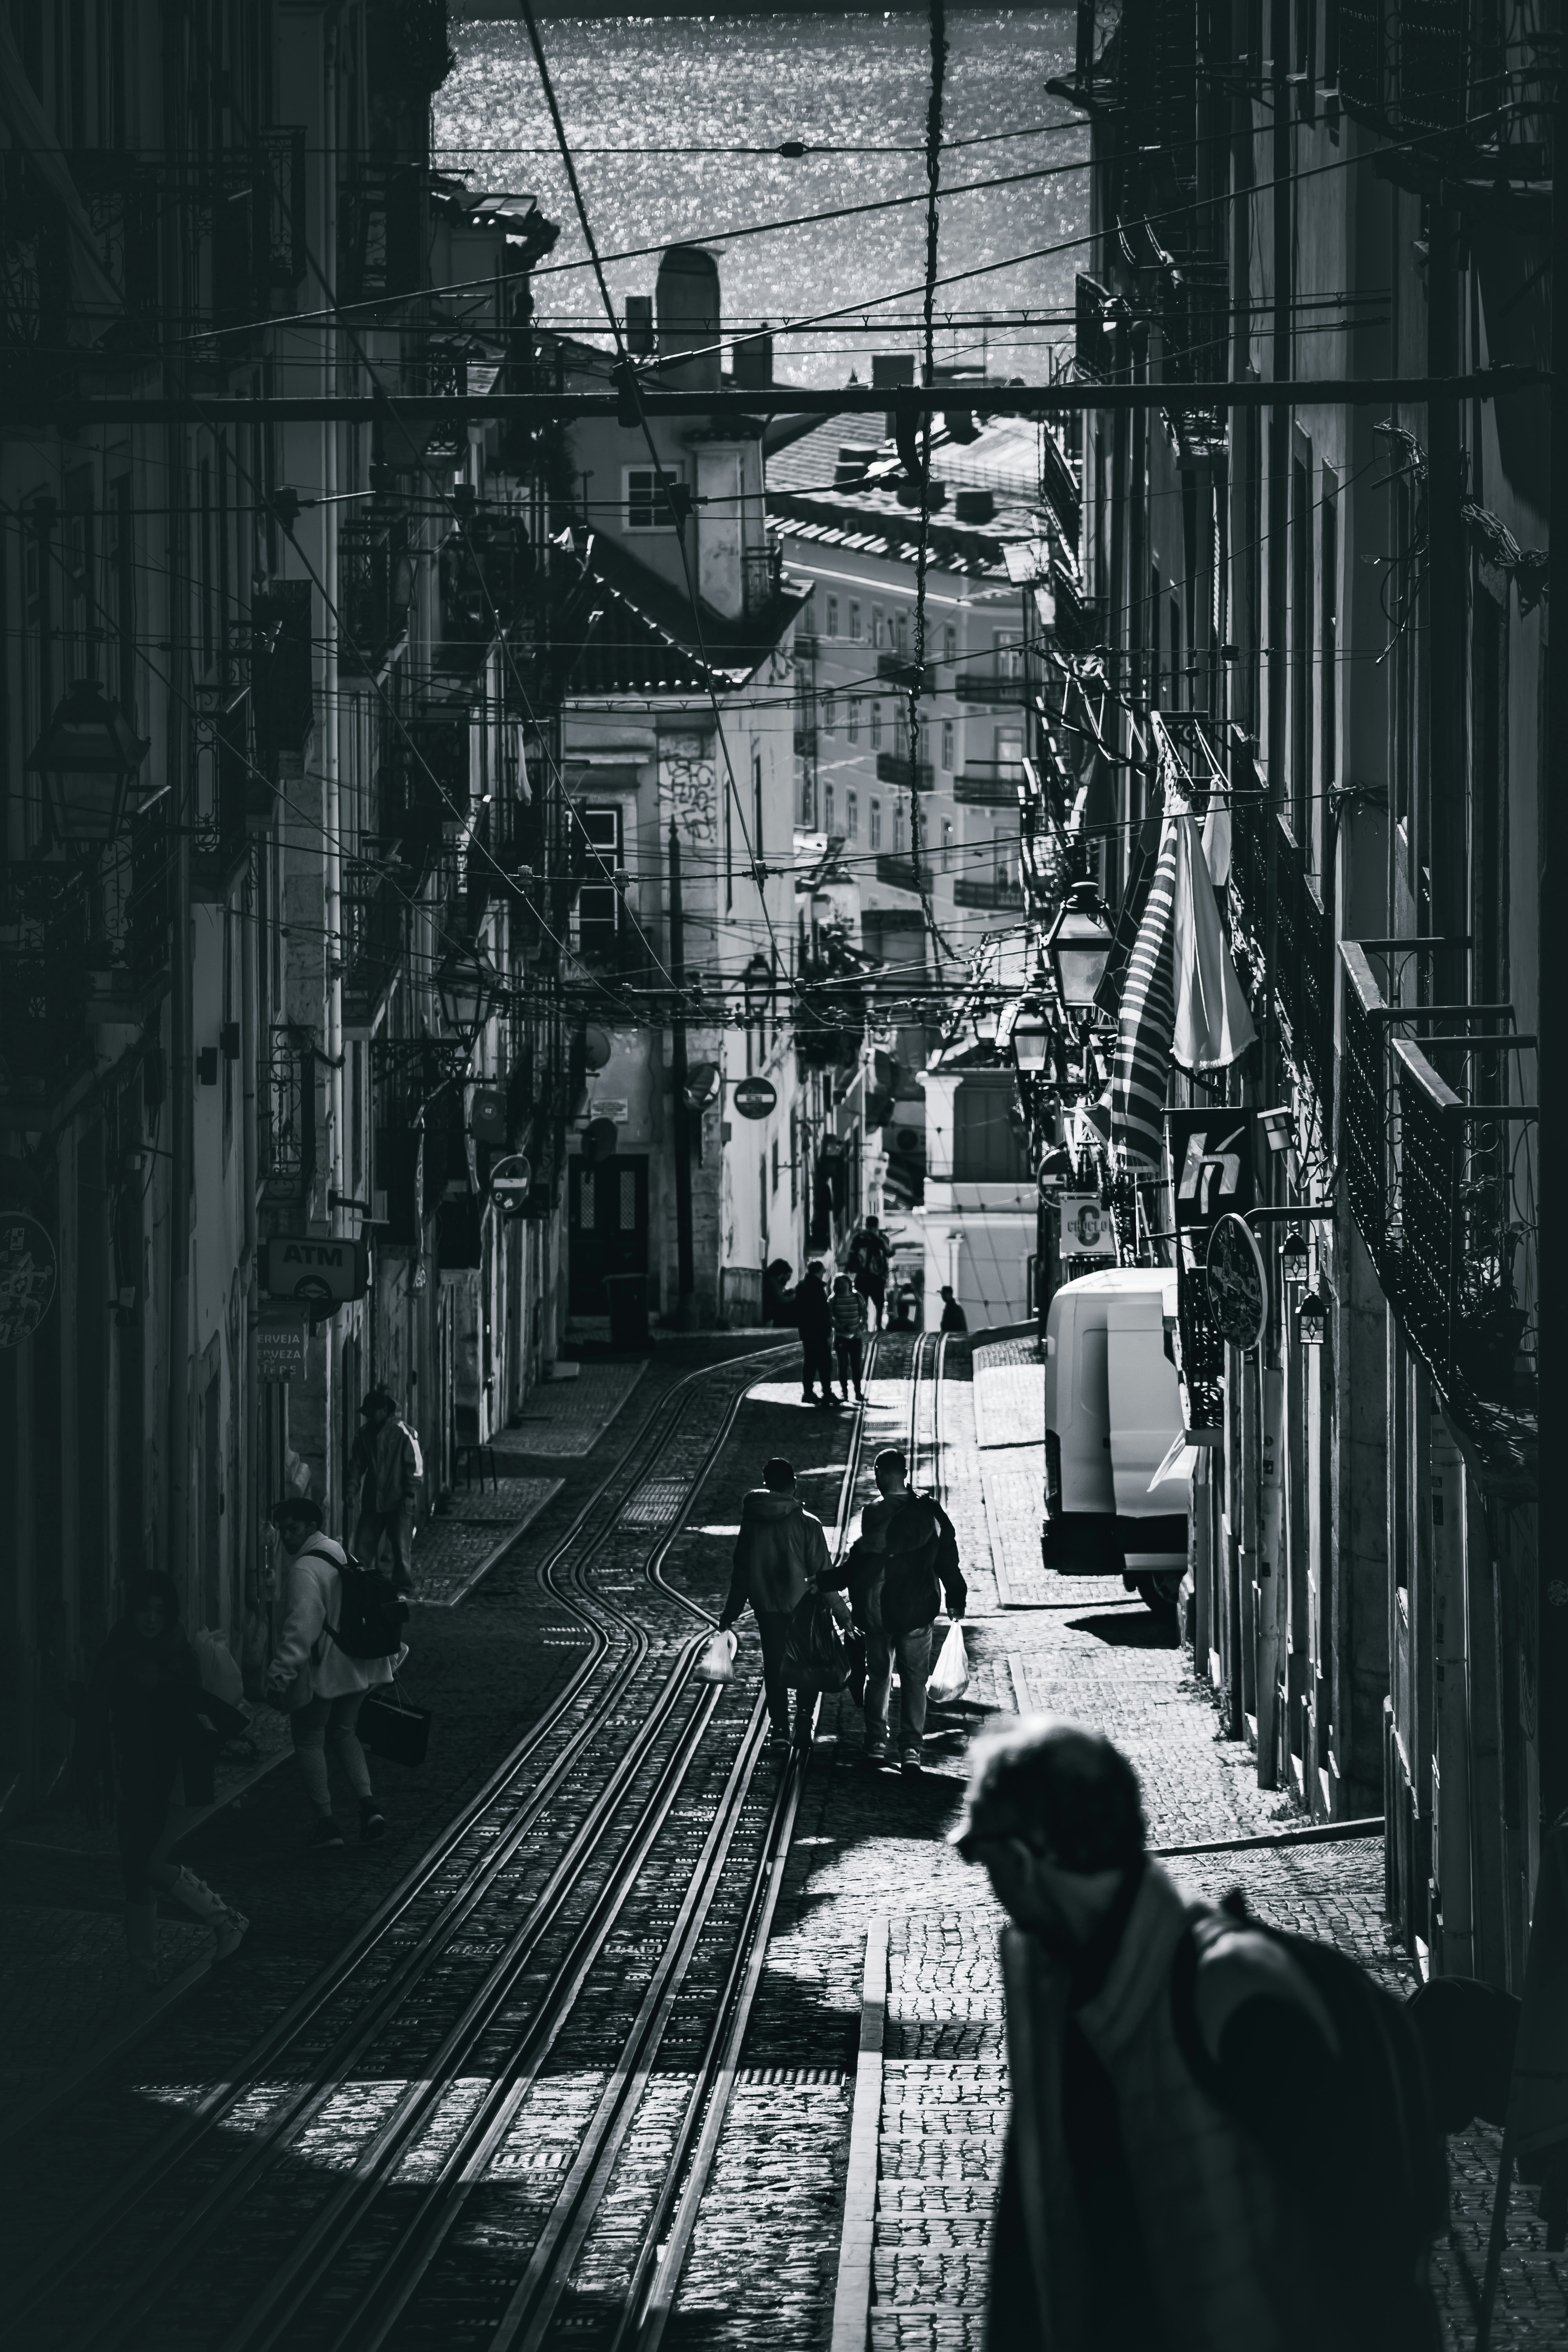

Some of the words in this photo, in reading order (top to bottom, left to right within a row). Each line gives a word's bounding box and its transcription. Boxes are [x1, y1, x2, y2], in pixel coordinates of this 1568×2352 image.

[282, 1244, 343, 1267] ATM
[257, 1334, 300, 1344] ERVEJA
[257, 1349, 301, 1358] ERVEZA
